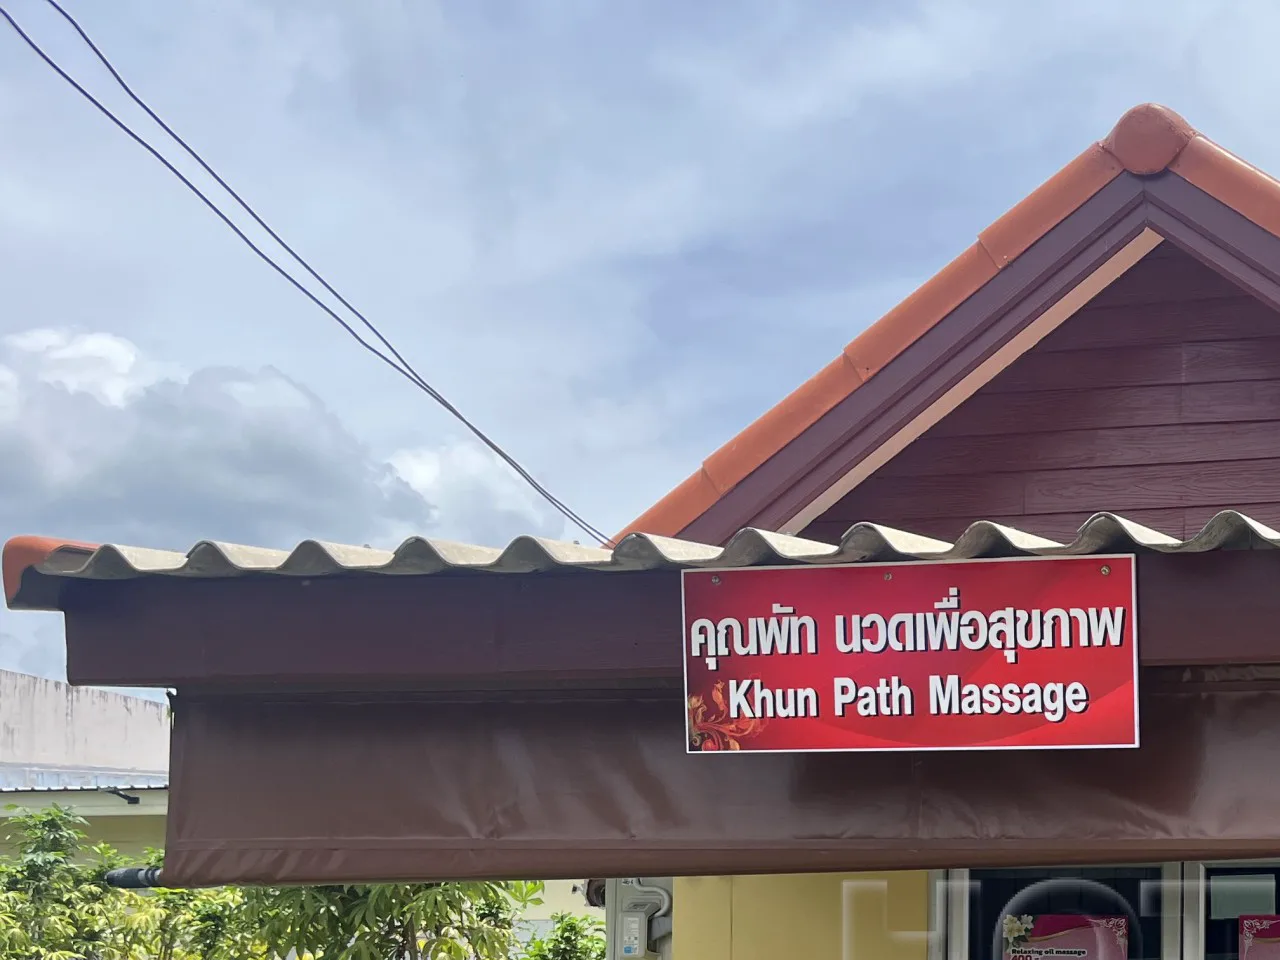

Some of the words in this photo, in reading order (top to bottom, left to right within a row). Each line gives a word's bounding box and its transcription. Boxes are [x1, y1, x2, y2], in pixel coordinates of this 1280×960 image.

[836, 587, 1124, 663] นวดเพื่อสุขภาพ
[729, 680, 817, 718] Khun
[834, 676, 912, 715] Path
[930, 675, 1087, 720] Massage
